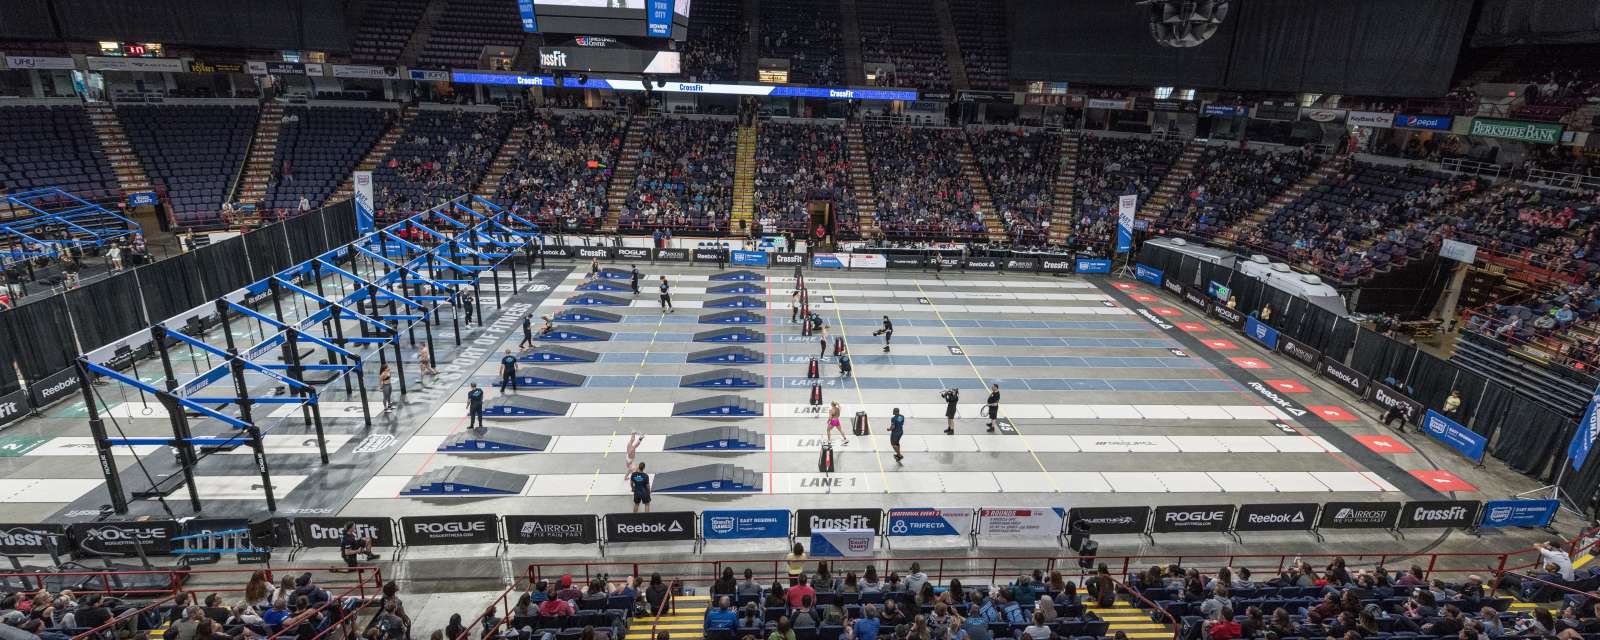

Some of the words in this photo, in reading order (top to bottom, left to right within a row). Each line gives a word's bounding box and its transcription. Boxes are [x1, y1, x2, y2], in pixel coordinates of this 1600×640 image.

[517, 76, 542, 85] CrossFit
[679, 84, 703, 92] CrossFit
[830, 90, 853, 98] CrossFit
[1417, 119, 1437, 127] pepsi
[580, 249, 607, 257] CrossFit
[776, 254, 802, 263] CrossFit
[1043, 261, 1069, 269] CrossFit
[491, 302, 533, 332] FITNESS
[1327, 365, 1351, 383] Reebok
[41, 376, 76, 398] Reebok
[1248, 381, 1293, 407] Reebok
[800, 477, 842, 487] LANE
[849, 477, 857, 487] 1
[1165, 511, 1224, 522] ROGUE
[1248, 513, 1291, 523] Reebok
[1348, 508, 1387, 518] AIRROSTI
[1413, 506, 1466, 521] CrossFit
[533, 522, 583, 532] AIRROSTI
[809, 514, 869, 530] CrossFit
[414, 521, 486, 534] ROGUE
[617, 522, 666, 534] Reebok
